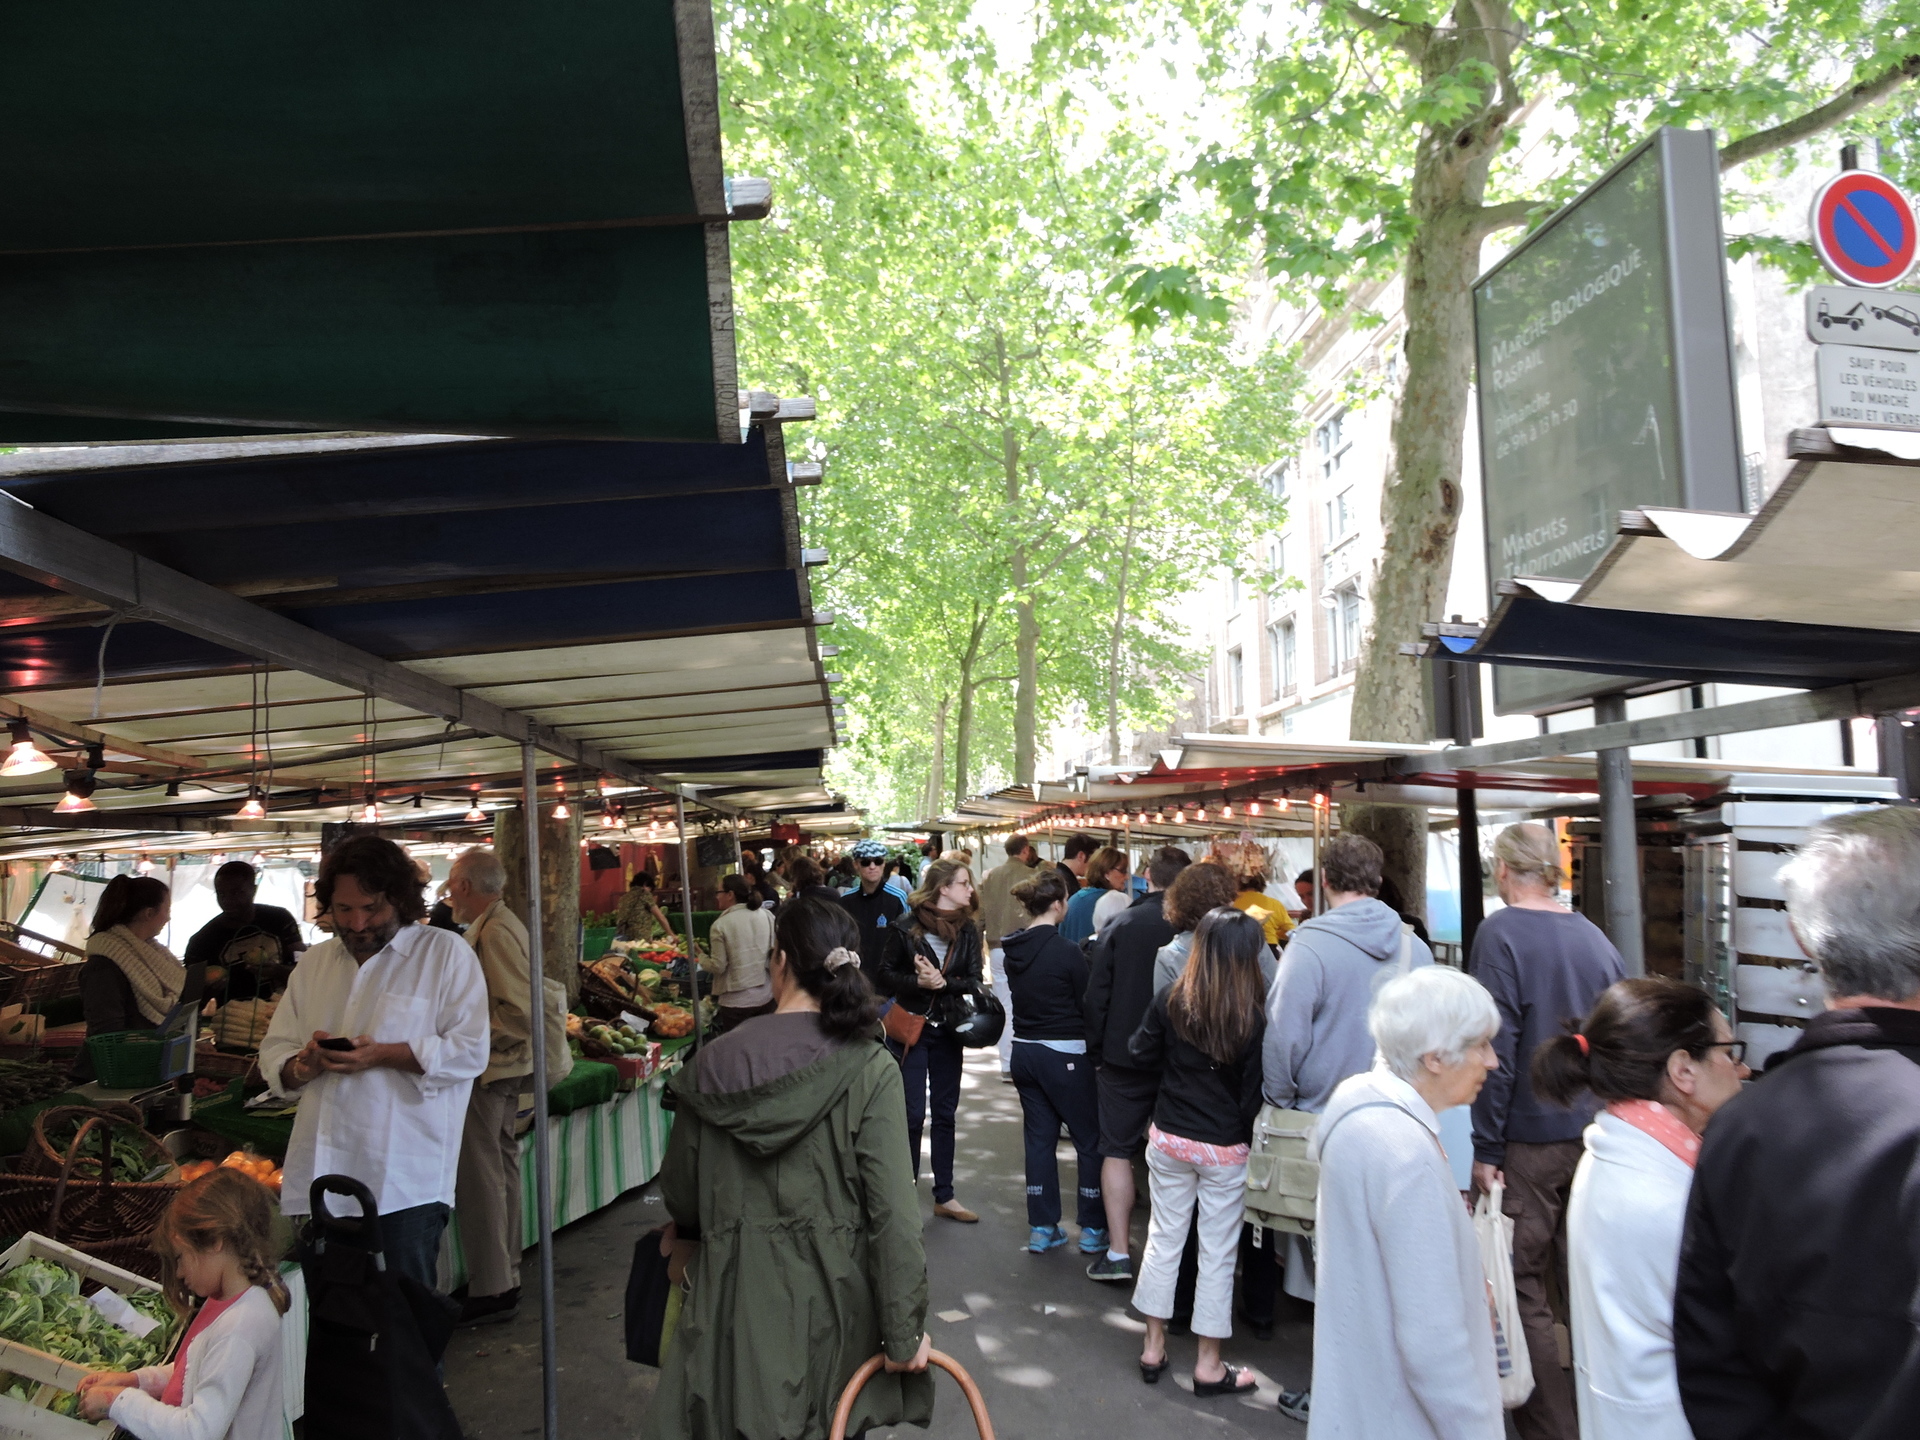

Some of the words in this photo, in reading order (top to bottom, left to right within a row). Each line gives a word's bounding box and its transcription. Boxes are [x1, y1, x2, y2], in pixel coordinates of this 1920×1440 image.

[1551, 248, 1641, 325] BIOLOGIQUE
[1492, 350, 1544, 392] RASPAIL
[1849, 356, 1875, 369] SAUF
[1880, 359, 1907, 373] POUR
[1840, 372, 1858, 385] LES
[1850, 390, 1865, 403] DU
[1830, 406, 1863, 419] MARDI
[1866, 409, 1878, 421] ET
